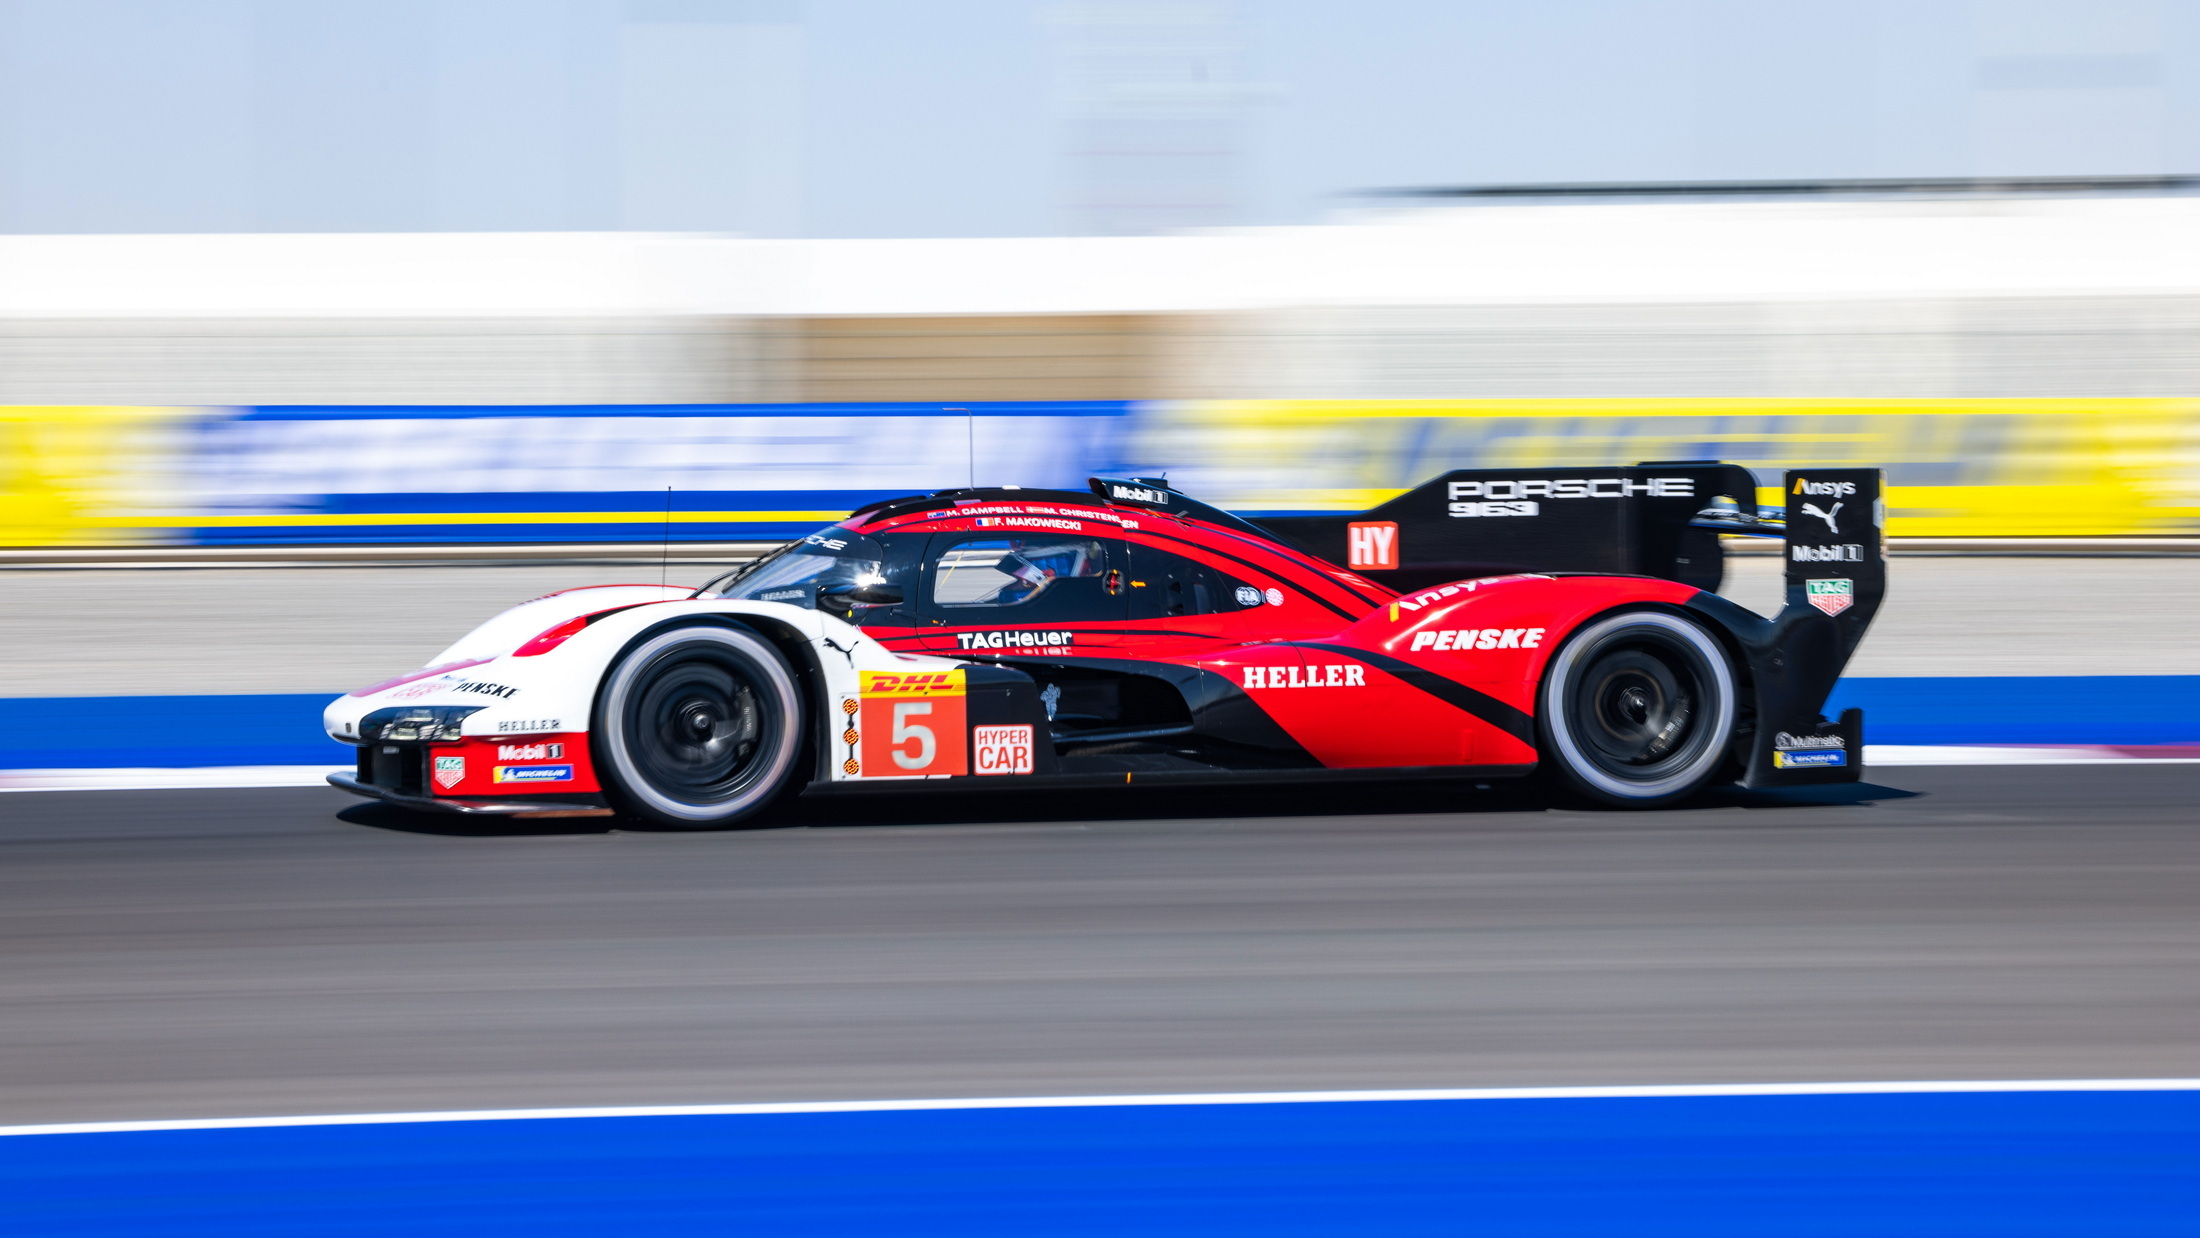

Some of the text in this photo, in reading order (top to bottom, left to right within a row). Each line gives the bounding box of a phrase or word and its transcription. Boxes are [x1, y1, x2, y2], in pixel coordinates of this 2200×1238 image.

[1113, 485, 1153, 502] Mobil
[1448, 478, 1694, 500] PORSCHE
[1792, 478, 1856, 498] Ansys
[962, 506, 1024, 516] CAMPBELL
[1448, 501, 1540, 518] 963
[994, 518, 1082, 531] F. MAKOWIECKI
[1059, 508, 1139, 529] CHRISTENSEN
[1350, 526, 1396, 565] HY
[1792, 545, 1842, 561] Mobil
[1810, 581, 1850, 594] TAG
[1389, 577, 1500, 622] Ansys
[1410, 628, 1546, 651] PENSKE
[868, 675, 957, 692] DHL
[1243, 664, 1366, 689] HELLER
[452, 682, 521, 699] PENSKE
[498, 719, 561, 732] HELLER
[891, 702, 936, 770] 5
[978, 729, 1028, 745] HYPER
[498, 744, 547, 761] Mobil
[979, 745, 1028, 769] CAR
[515, 768, 567, 779] MICHELIN
